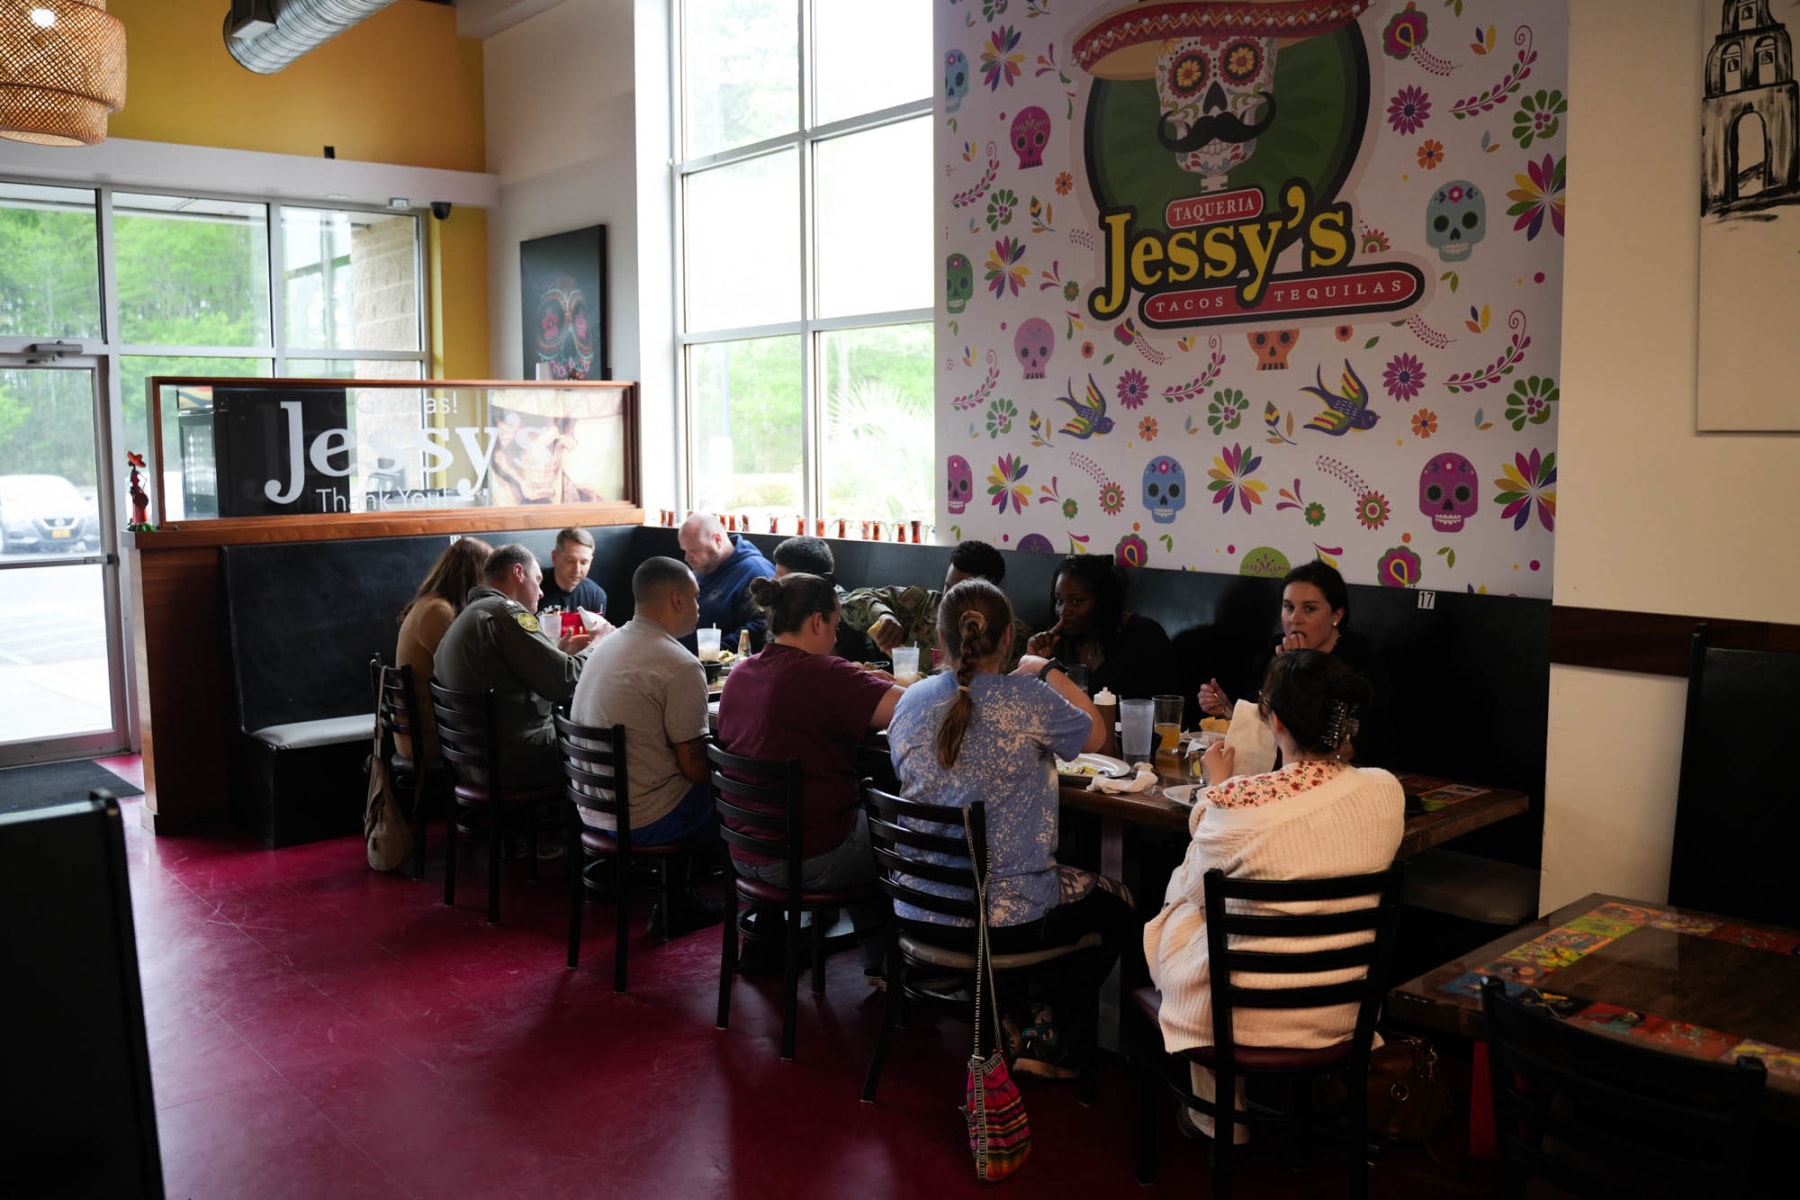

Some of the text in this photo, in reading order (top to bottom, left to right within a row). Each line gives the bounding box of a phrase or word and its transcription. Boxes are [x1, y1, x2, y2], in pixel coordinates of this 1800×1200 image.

[1173, 196, 1255, 223] TAQUERIA
[1094, 186, 1347, 314] Jessy's
[1156, 280, 1401, 313] TACOS TEQUILAS
[356, 390, 459, 414] Gras!
[315, 484, 447, 512] Thank You!
[1421, 591, 1433, 608] 17
